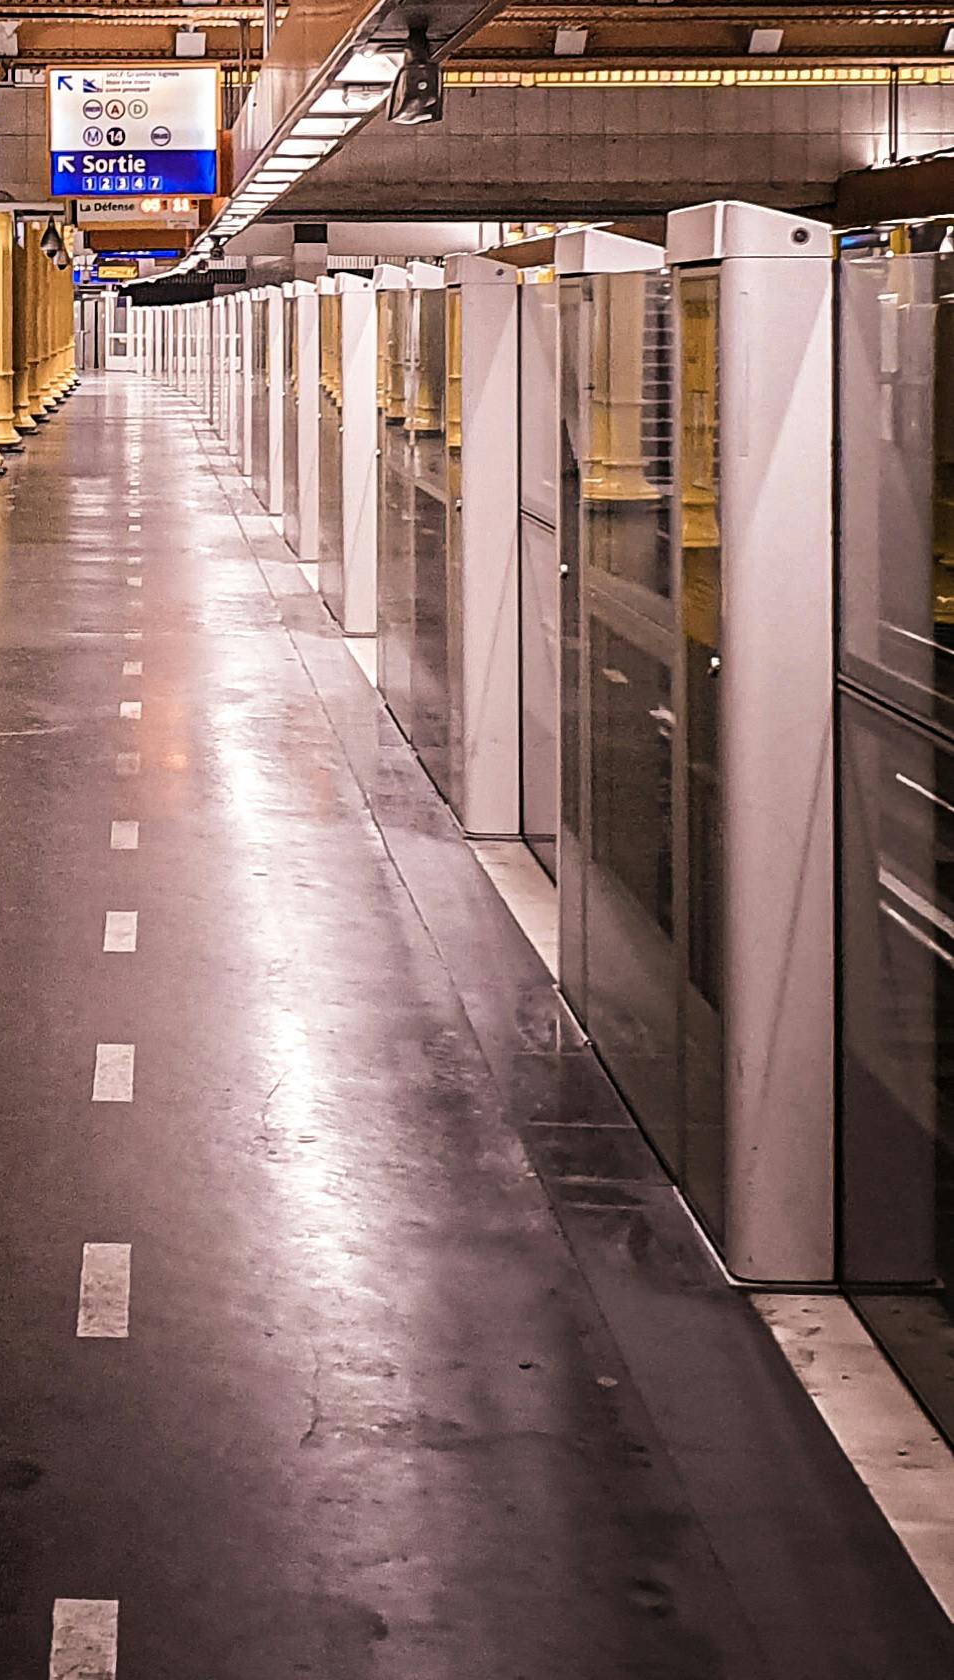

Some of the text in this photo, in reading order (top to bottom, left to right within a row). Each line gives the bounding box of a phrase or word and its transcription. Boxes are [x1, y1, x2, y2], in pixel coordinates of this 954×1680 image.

[111, 104, 120, 114] A
[133, 104, 143, 114] D
[87, 130, 99, 142] M
[108, 130, 123, 143] 14
[82, 153, 146, 173] Sortie
[79, 202, 91, 212] La
[94, 201, 134, 212] Défense
